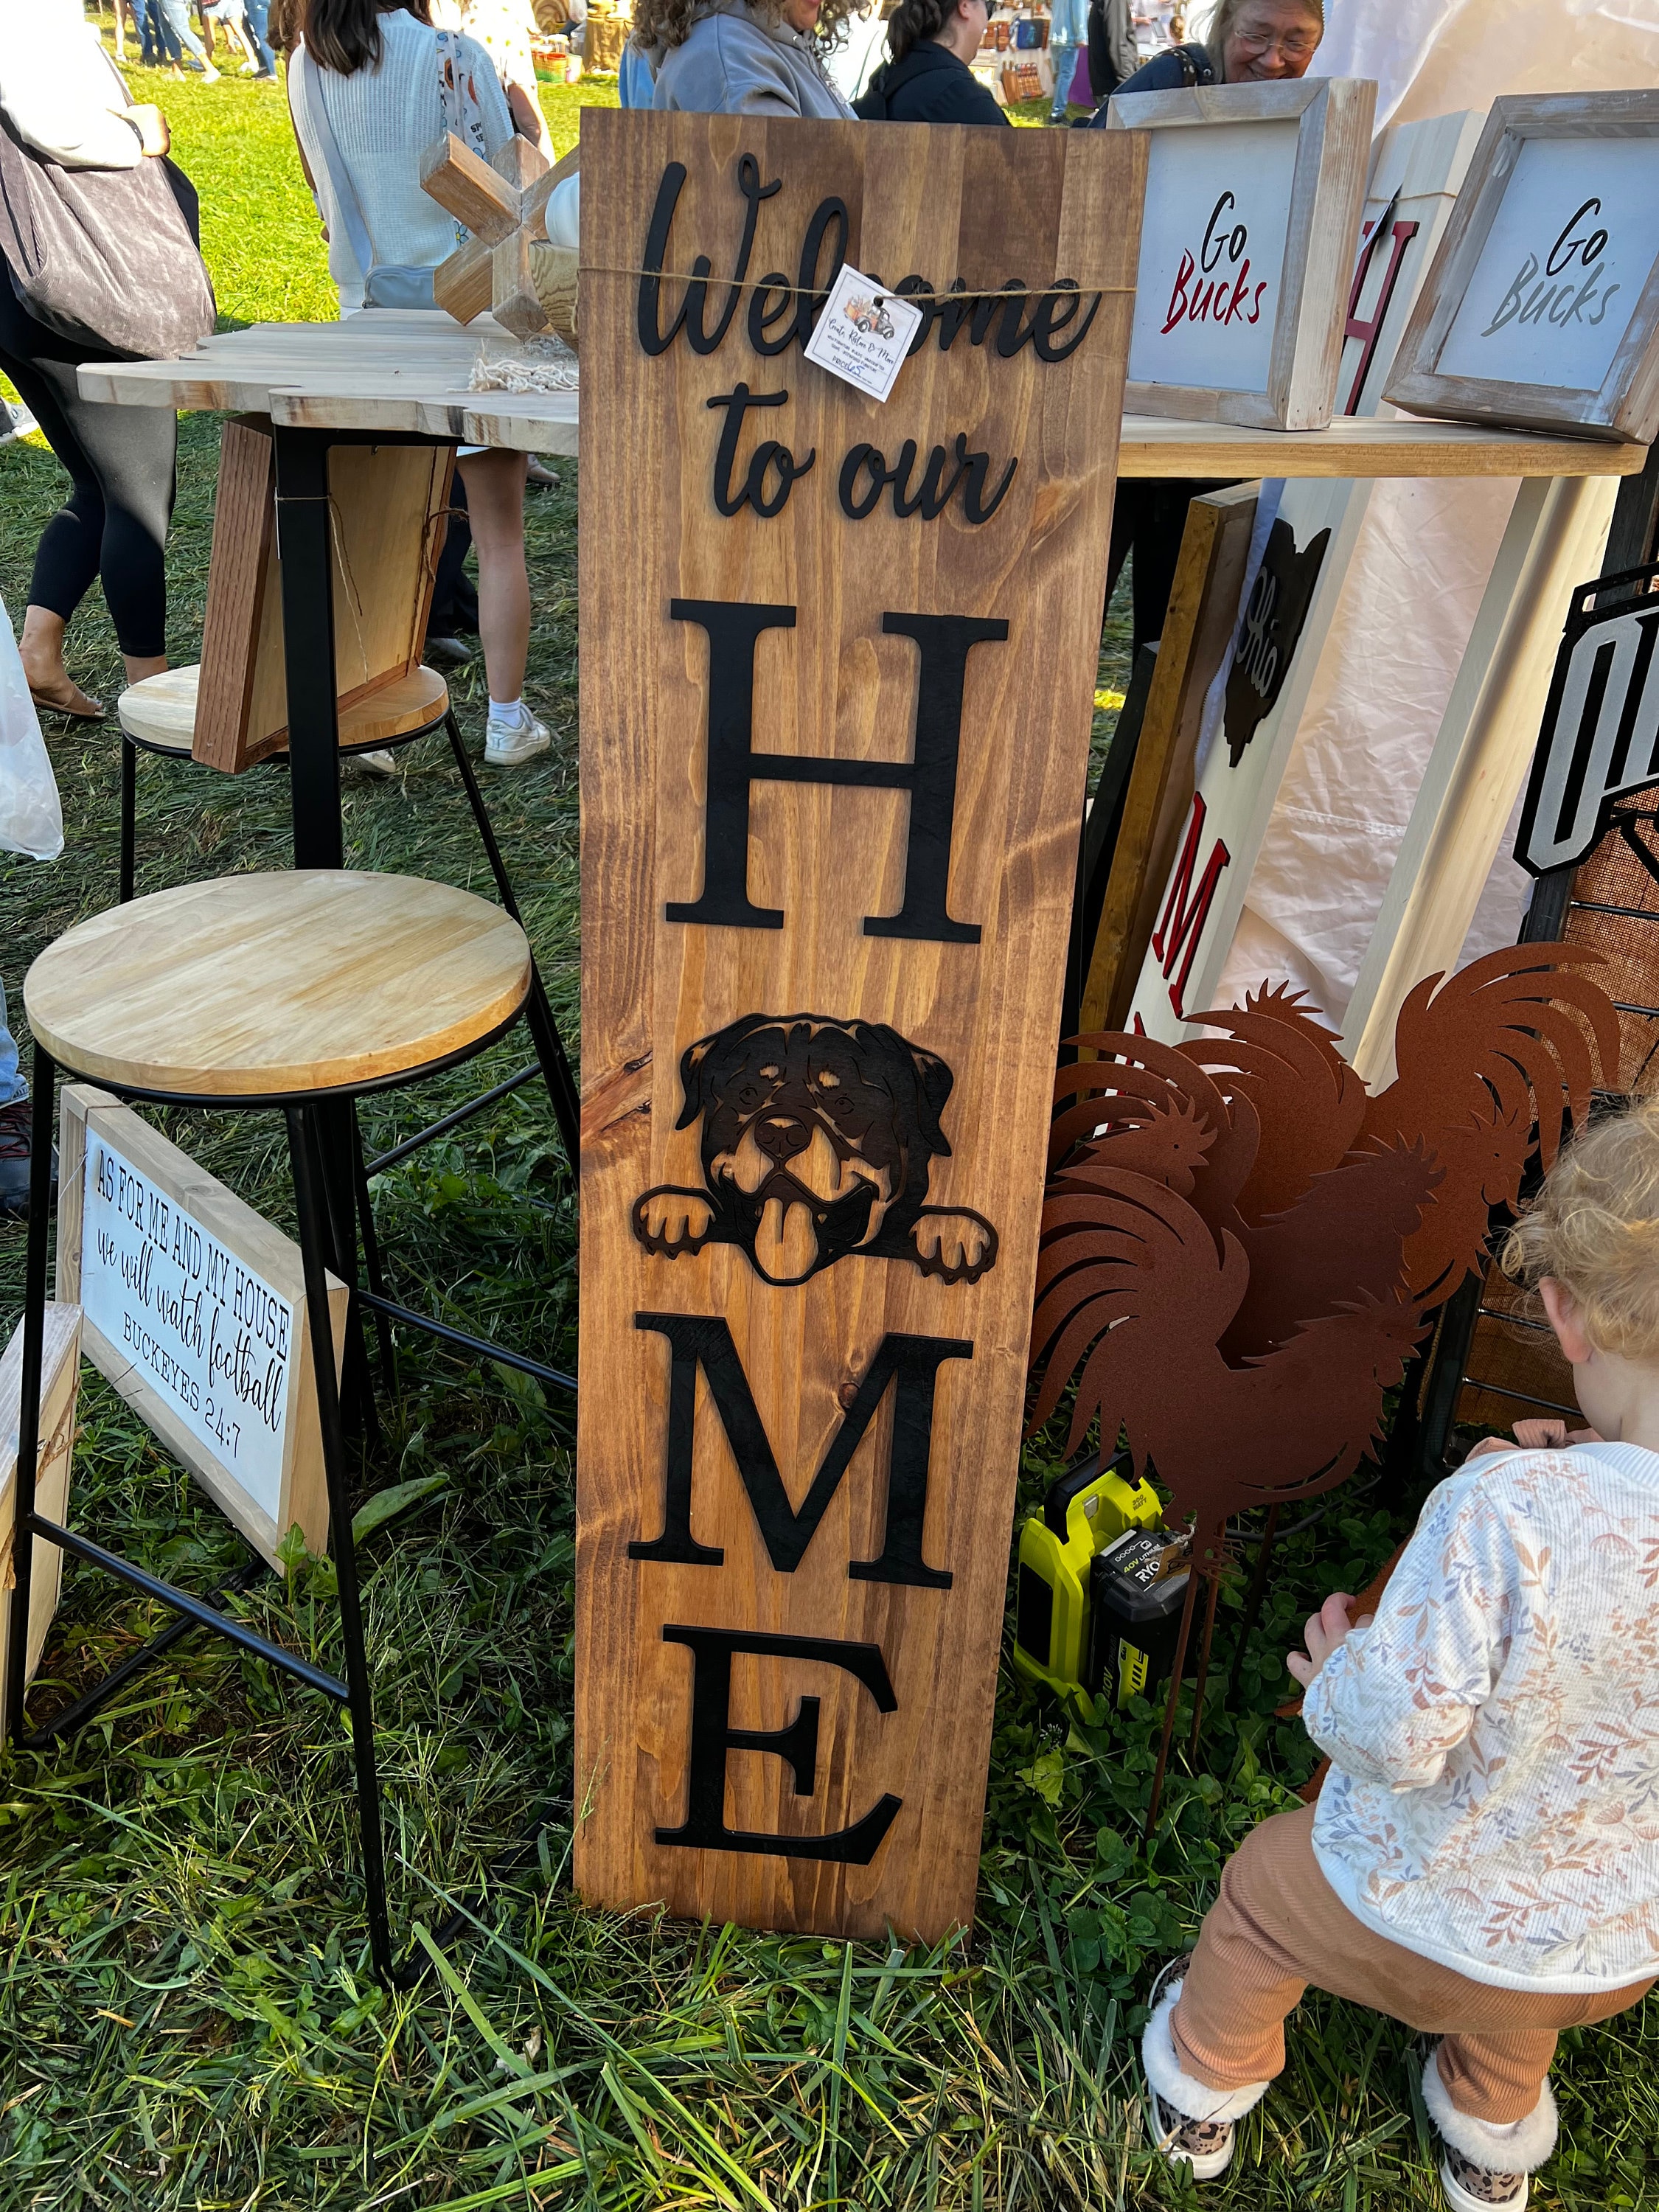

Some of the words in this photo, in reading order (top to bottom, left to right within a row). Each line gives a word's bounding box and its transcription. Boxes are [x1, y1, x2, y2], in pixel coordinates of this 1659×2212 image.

[637, 152, 1102, 362] Welome
[1201, 191, 1247, 273] Go
[1546, 198, 1608, 276] Go
[706, 382, 815, 517] to
[838, 432, 1018, 524] our
[666, 598, 1009, 944] H
[1151, 791, 1231, 1020] M
[97, 1150, 114, 1203] AS
[118, 1166, 144, 1232] FOR
[147, 1192, 169, 1253] ME
[172, 1215, 201, 1280] AND
[206, 1243, 230, 1307] MY
[233, 1267, 289, 1362] HOUSE
[97, 1228, 117, 1267] we
[121, 1240, 153, 1307] will
[157, 1278, 206, 1358] watch
[209, 1307, 283, 1433] football
[123, 1311, 199, 1412] BUCKEYES
[205, 1397, 240, 1458] 24:7
[628, 1311, 974, 1589] M
[1124, 1558, 1139, 1573] 40V
[1135, 1561, 1161, 1582] RYO
[655, 1624, 902, 1865] E
